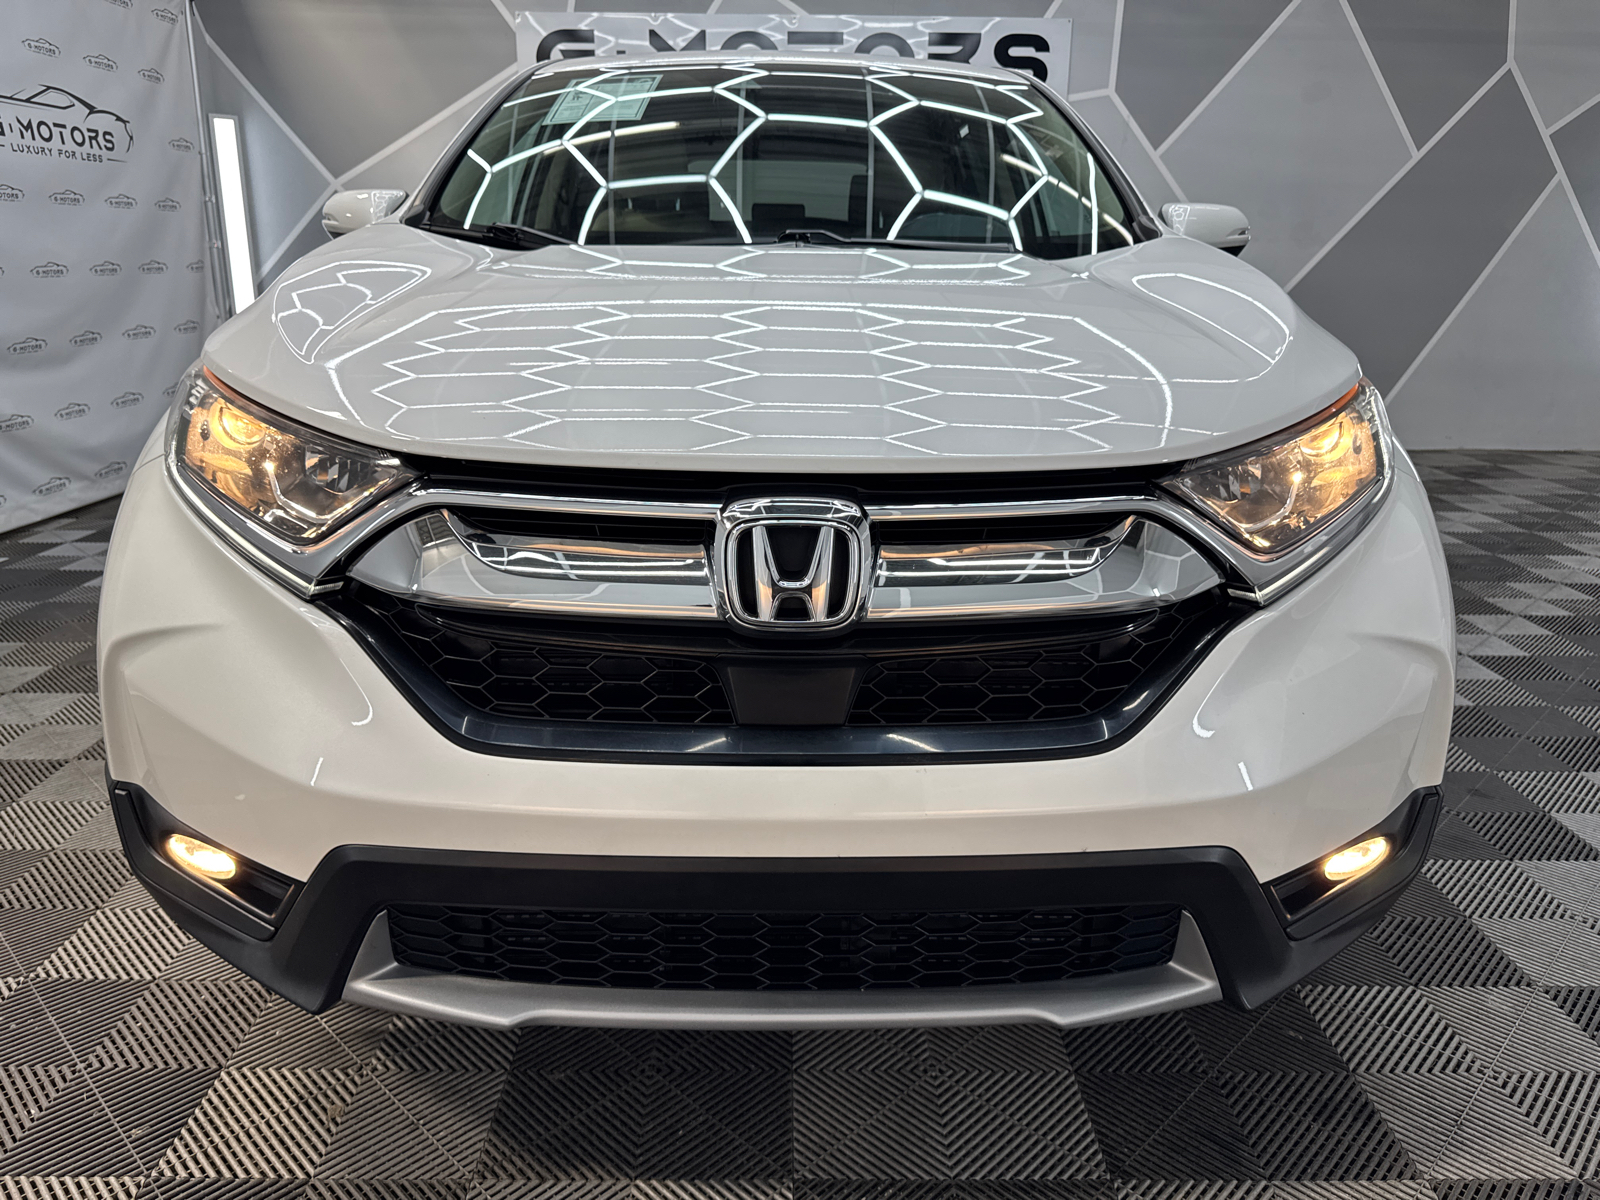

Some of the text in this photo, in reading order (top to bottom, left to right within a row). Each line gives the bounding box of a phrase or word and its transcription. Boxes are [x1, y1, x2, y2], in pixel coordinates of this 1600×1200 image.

[10, 142, 103, 163] LUXURY FOR LESS
